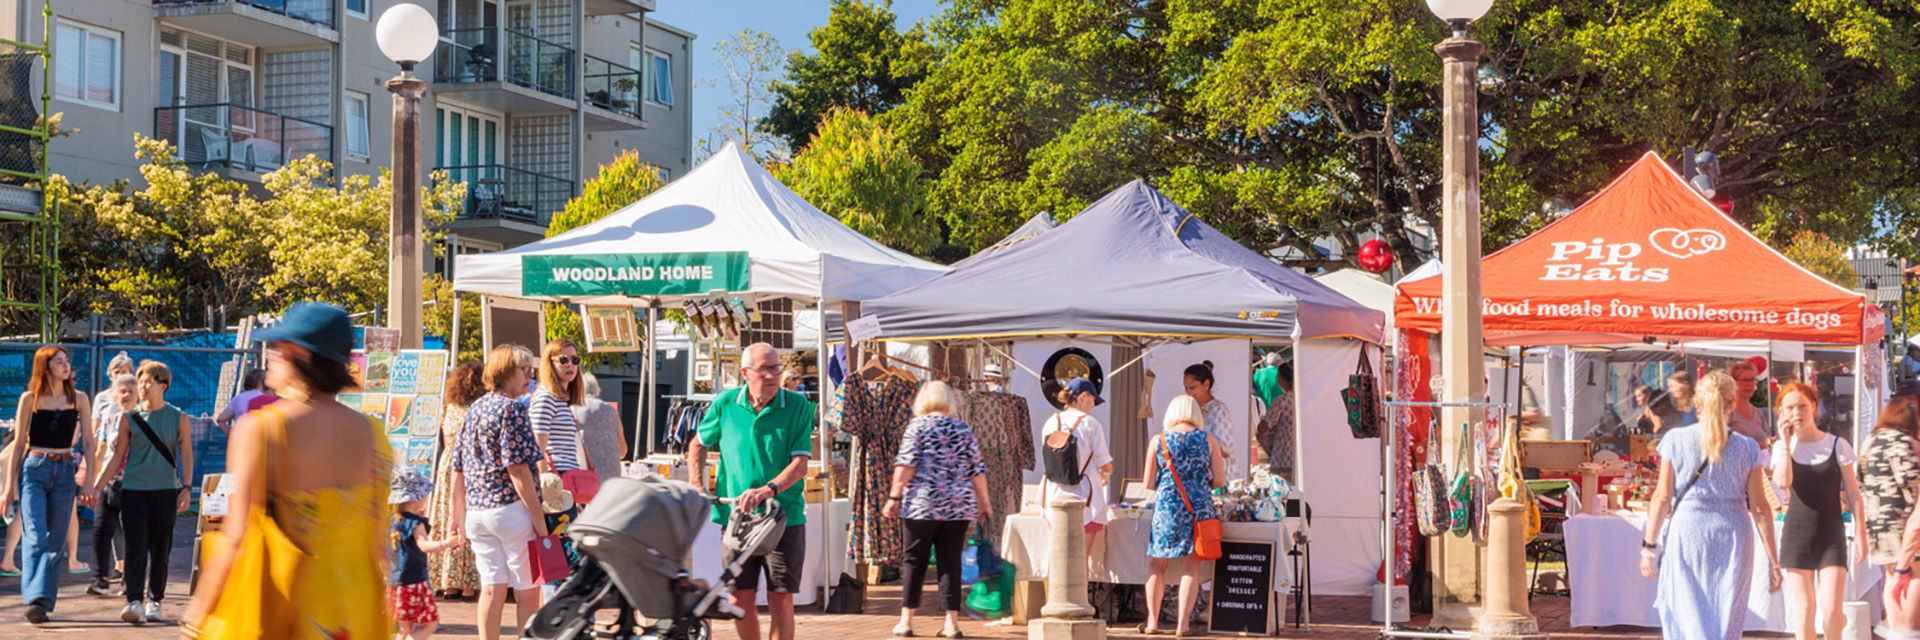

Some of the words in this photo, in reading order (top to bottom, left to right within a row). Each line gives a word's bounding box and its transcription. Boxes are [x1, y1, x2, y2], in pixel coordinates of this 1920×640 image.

[1546, 237, 1642, 266] Pip
[552, 266, 655, 282] WOODLAND
[659, 265, 714, 281] HOME
[1538, 262, 1669, 283] Eats
[1537, 299, 1603, 317] meals
[1610, 299, 1643, 318] for
[1650, 302, 1779, 324] wholesome
[1786, 307, 1842, 330] dogs
[391, 367, 416, 379] you
